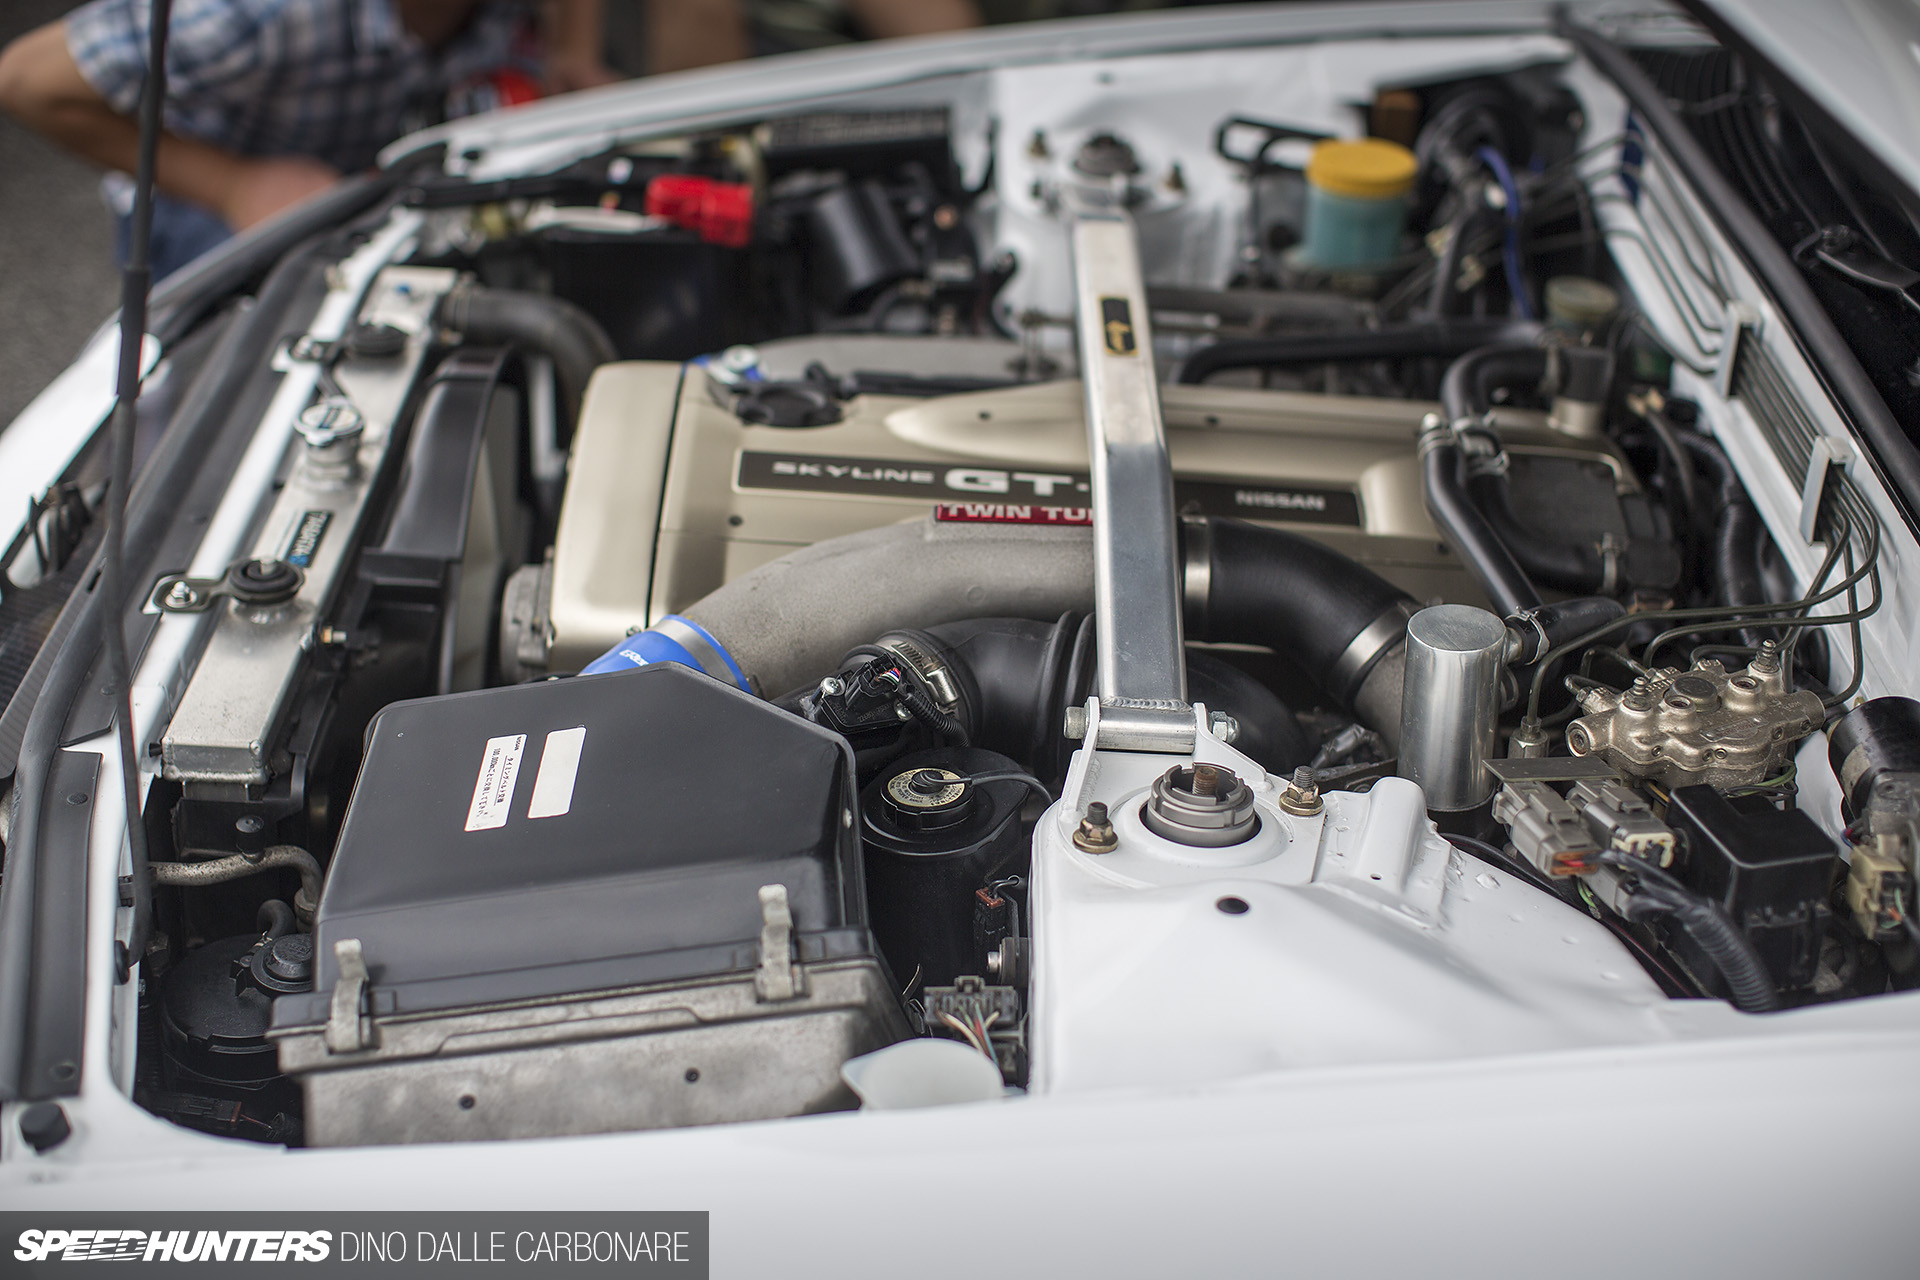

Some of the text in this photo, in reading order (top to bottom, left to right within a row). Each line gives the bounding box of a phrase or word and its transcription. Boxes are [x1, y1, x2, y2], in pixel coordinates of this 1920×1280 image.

[772, 461, 1090, 497] SKYLINE GT-
[1235, 490, 1325, 511] NISSAN
[940, 503, 1093, 522] TWIN TU
